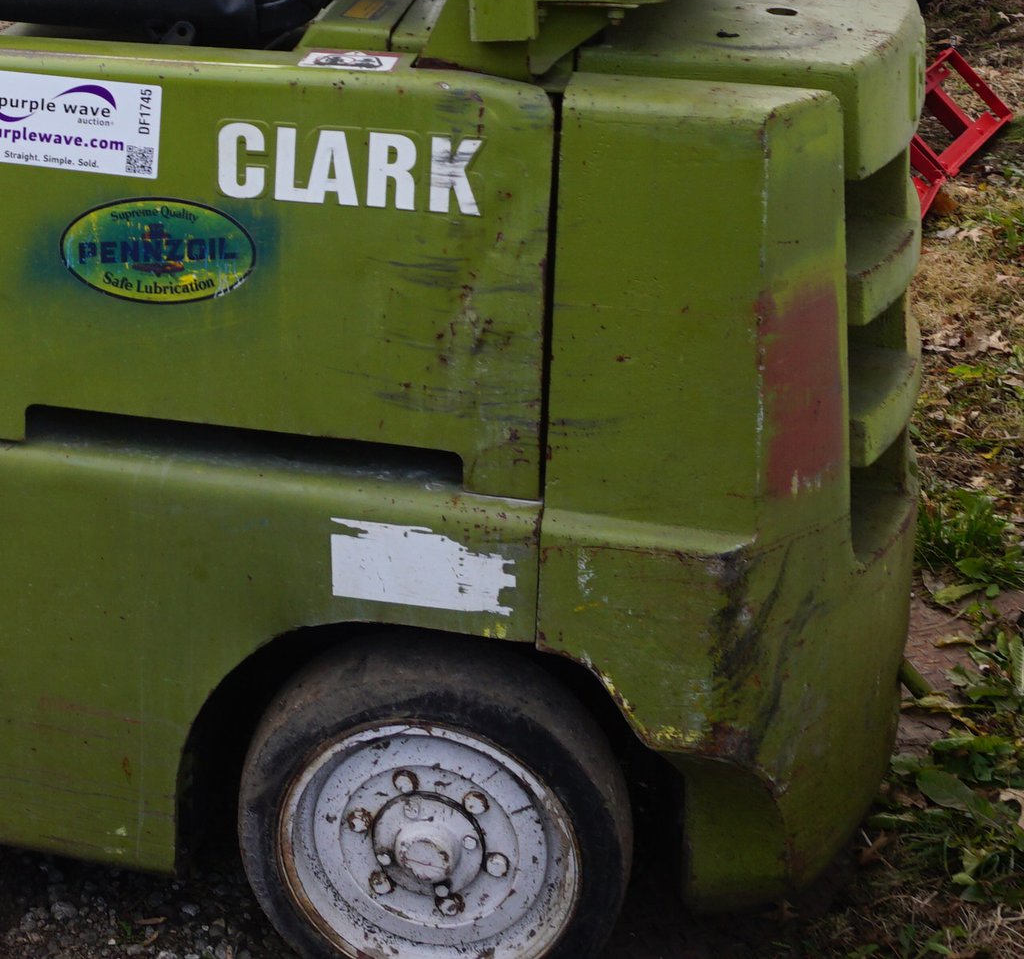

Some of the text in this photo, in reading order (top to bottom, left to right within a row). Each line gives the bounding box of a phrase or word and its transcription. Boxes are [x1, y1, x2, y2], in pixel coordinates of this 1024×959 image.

[63, 104, 111, 118] wave
[77, 117, 111, 127] auction
[138, 89, 153, 135] DF1745
[4, 150, 100, 168] Straight. Simple. Sold.
[217, 121, 483, 217] CLARK
[110, 205, 199, 223] Supreme Quality
[78, 237, 240, 265] PENNZOIL
[103, 270, 216, 296] Safe Lubrication
